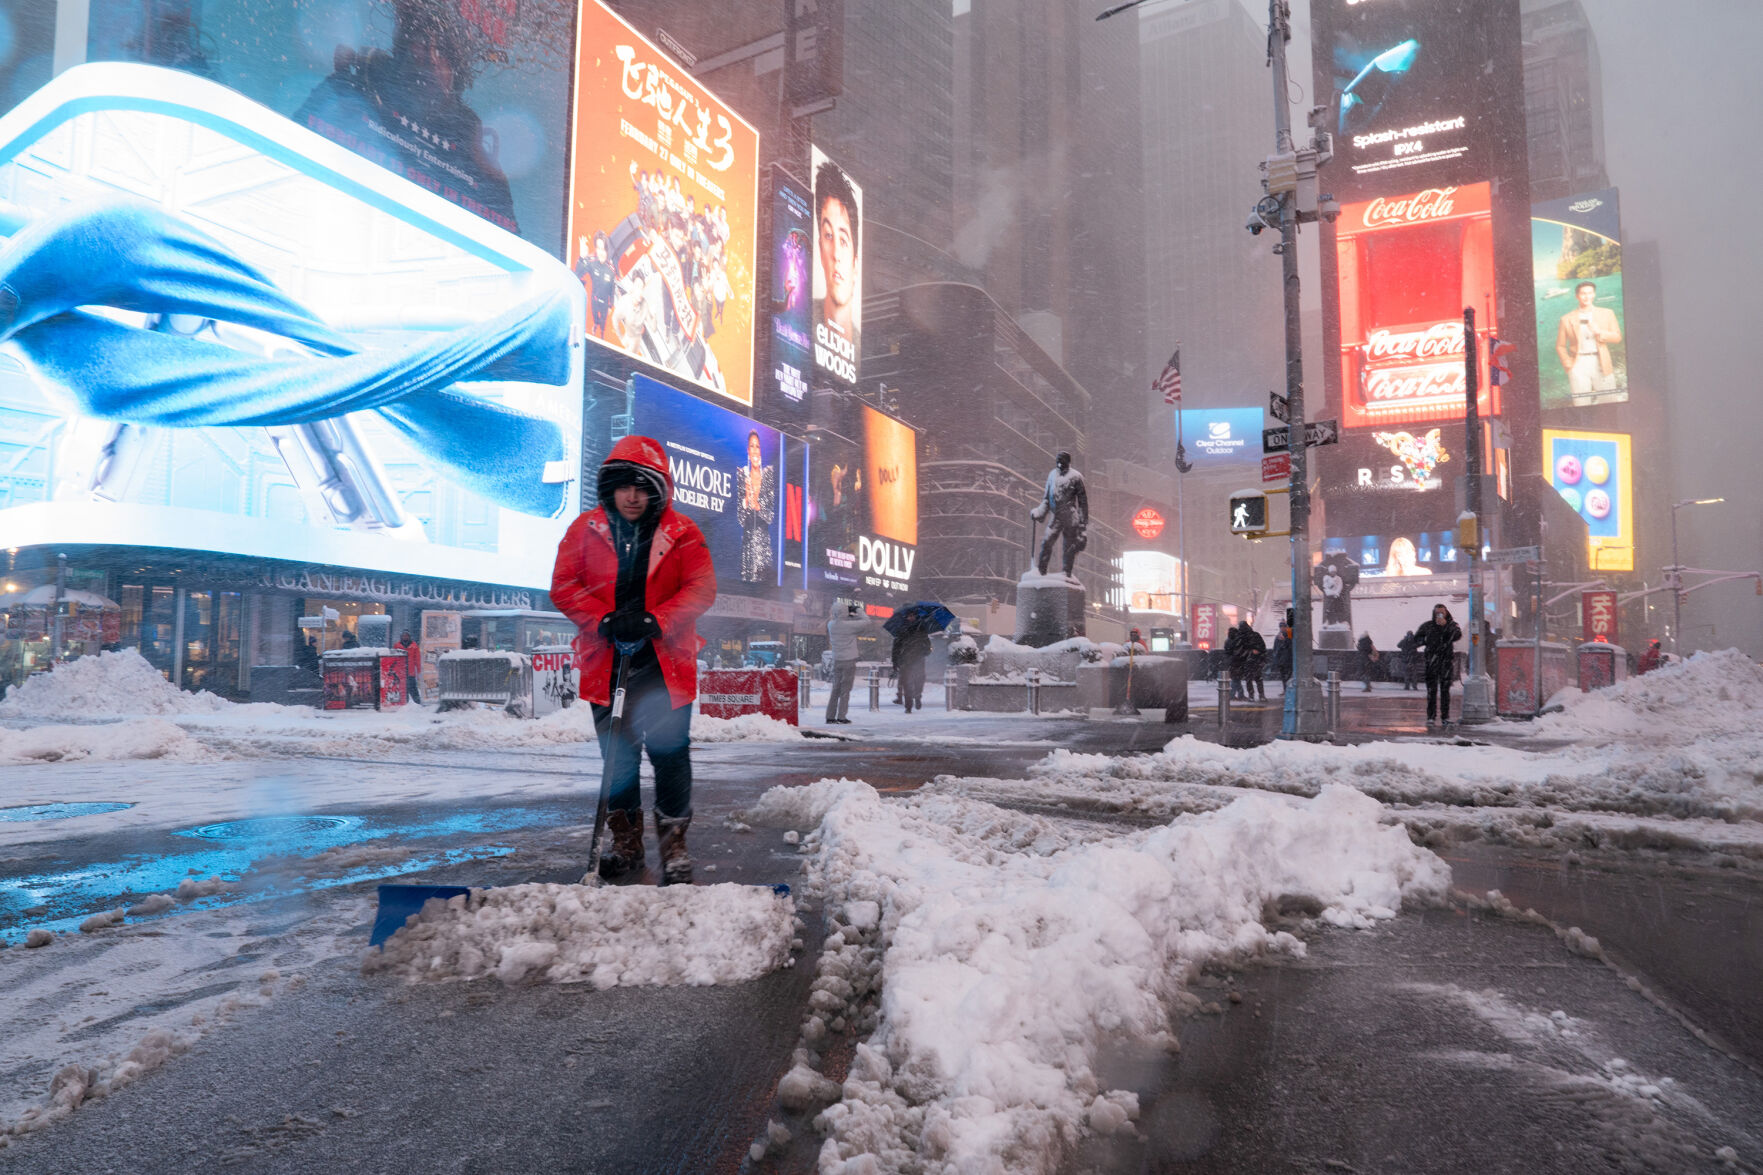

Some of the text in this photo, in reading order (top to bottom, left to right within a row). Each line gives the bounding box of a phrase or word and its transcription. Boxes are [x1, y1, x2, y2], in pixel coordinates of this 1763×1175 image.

[620, 118, 659, 155] FEBRUARY
[1353, 115, 1465, 149] Splash-resistant
[1394, 140, 1423, 156] IPX4
[461, 194, 520, 234] THEATERS
[1363, 186, 1458, 227] Coca-Cola
[814, 343, 857, 384] WOODS
[1196, 439, 1245, 447] Clear Channel
[1206, 447, 1234, 455] Outdoor
[1273, 428, 1327, 445] ON WAY
[710, 495, 726, 514] FLY
[859, 536, 916, 580] DOLLY
[341, 575, 414, 598] EAGLE
[1197, 605, 1213, 639] tkts
[1592, 593, 1612, 633] tkts
[708, 694, 754, 704] TIMES SQUARE
